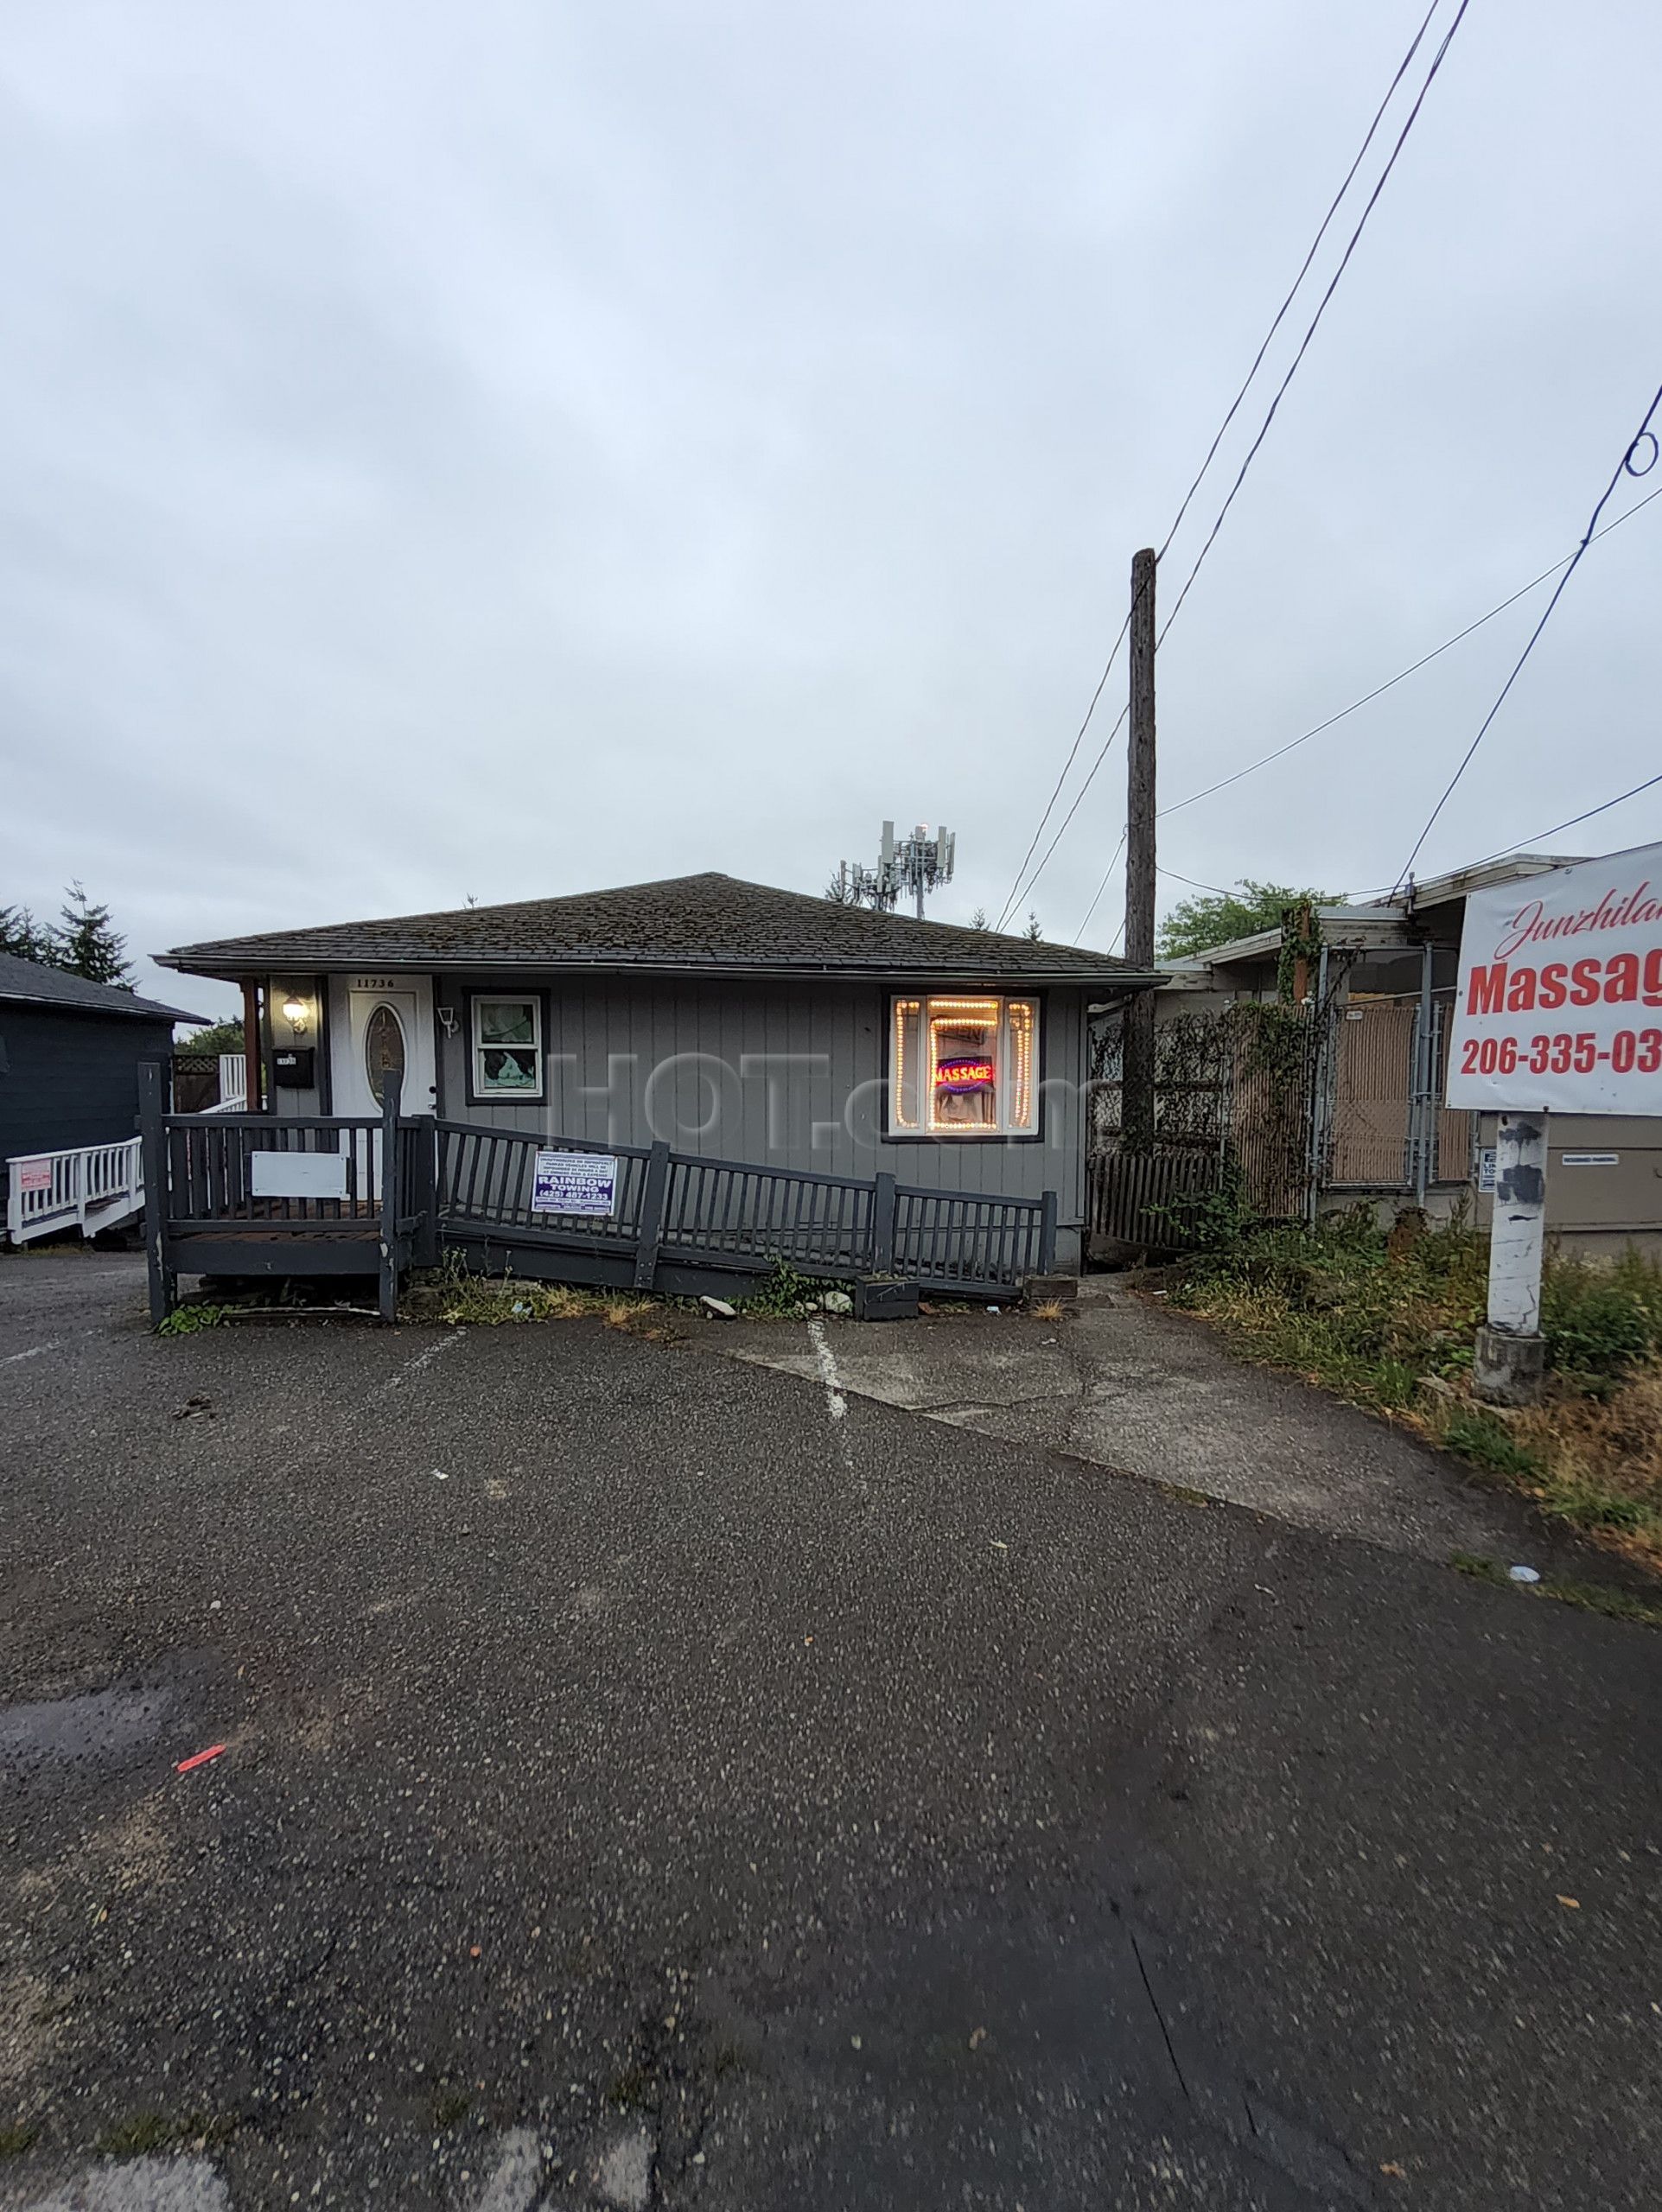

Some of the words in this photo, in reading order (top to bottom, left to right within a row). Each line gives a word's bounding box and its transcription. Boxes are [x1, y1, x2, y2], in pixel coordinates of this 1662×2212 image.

[1494, 880, 1662, 960] Junzhila
[357, 978, 395, 988] 11736
[538, 1176, 612, 1188] RAINBOW
[550, 1184, 600, 1192] TOWING
